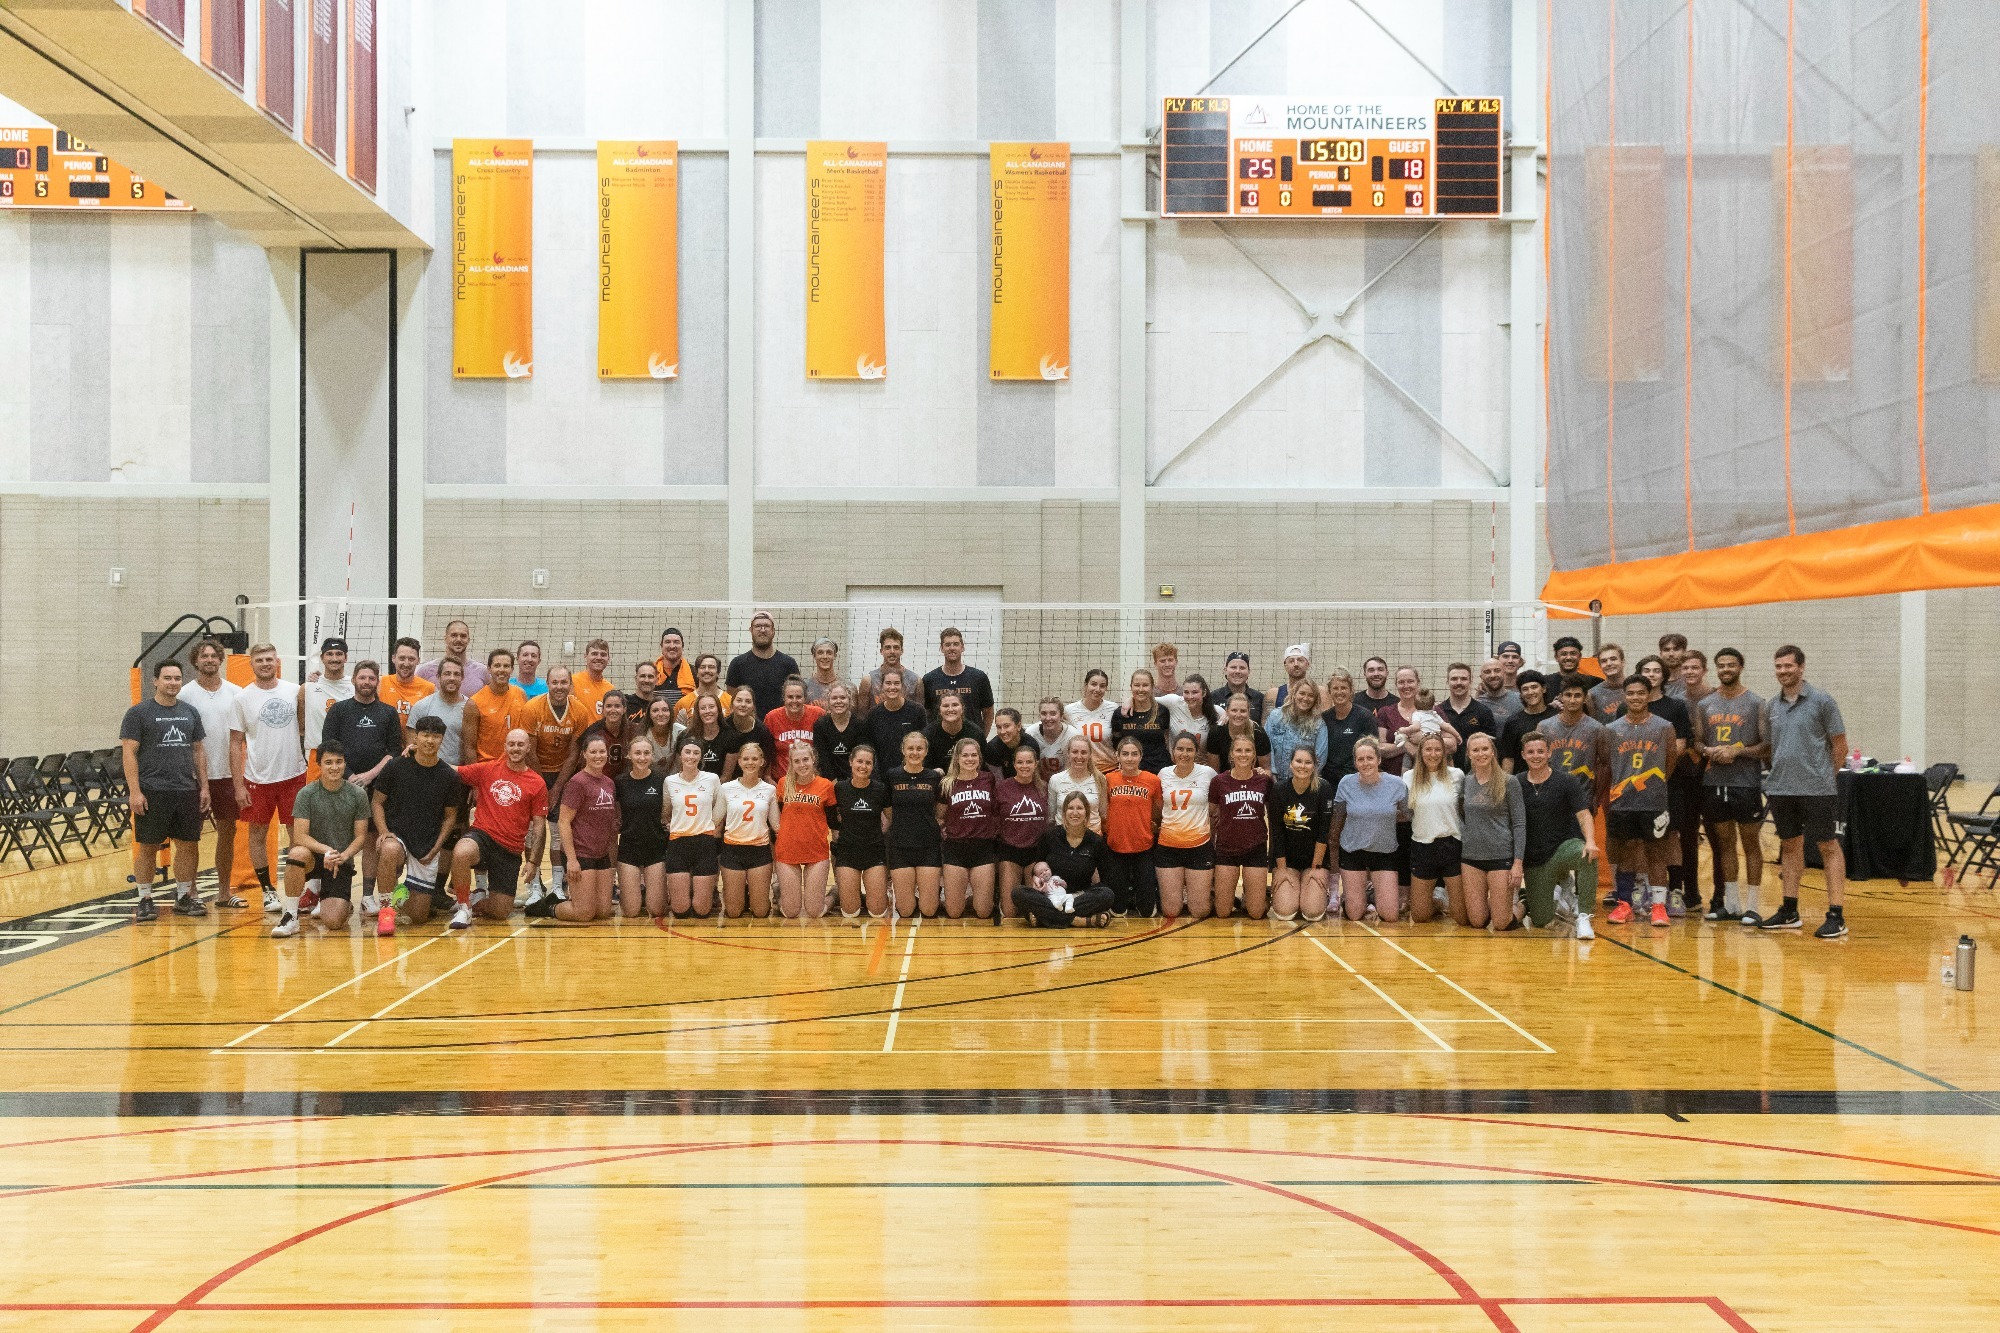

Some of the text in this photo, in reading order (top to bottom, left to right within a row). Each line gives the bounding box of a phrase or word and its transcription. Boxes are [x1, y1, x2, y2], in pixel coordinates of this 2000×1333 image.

[1166, 99, 1186, 111] PLY
[1191, 99, 1204, 111] AC
[1287, 104, 1382, 115] HOME OF THE
[1436, 99, 1457, 112] PLY
[1461, 99, 1475, 112] AC
[1287, 117, 1427, 130] MOUNTAINEERS
[1240, 140, 1273, 152] HOME
[1310, 141, 1362, 161] 15:00
[1389, 141, 1426, 153] GUEST
[17, 149, 28, 168] 0
[64, 161, 93, 170] PERIOD
[469, 158, 529, 167] ALL-CANADIANS
[612, 158, 673, 166] ALL-CANADIANS
[823, 160, 883, 168] ALL-CANADIANS
[496, 167, 521, 175] Country
[1248, 159, 1273, 178] 25
[1309, 170, 1336, 179] PERIOD
[1404, 159, 1423, 178] 18
[2, 181, 12, 196] 0
[1248, 191, 1258, 205] 0
[1280, 191, 1291, 206] 0
[1373, 191, 1384, 206] 0
[1412, 191, 1422, 206] 0
[457, 175, 466, 300] mountaineers
[601, 177, 610, 302] mountaineers
[811, 178, 820, 303] mountaineers
[994, 179, 1003, 304] mountaineers
[469, 265, 529, 273] ALL-CANADIANS
[1081, 722, 1103, 743] 10
[1716, 726, 1732, 742] 12
[1562, 751, 1573, 766] 2
[1632, 752, 1643, 769] 6
[951, 789, 991, 806] MOHAWK
[1110, 785, 1149, 799] MOHAWK
[1224, 790, 1265, 805] MOHAWK
[684, 794, 698, 817] 5
[1169, 789, 1193, 811] 17
[742, 800, 755, 822] 2
